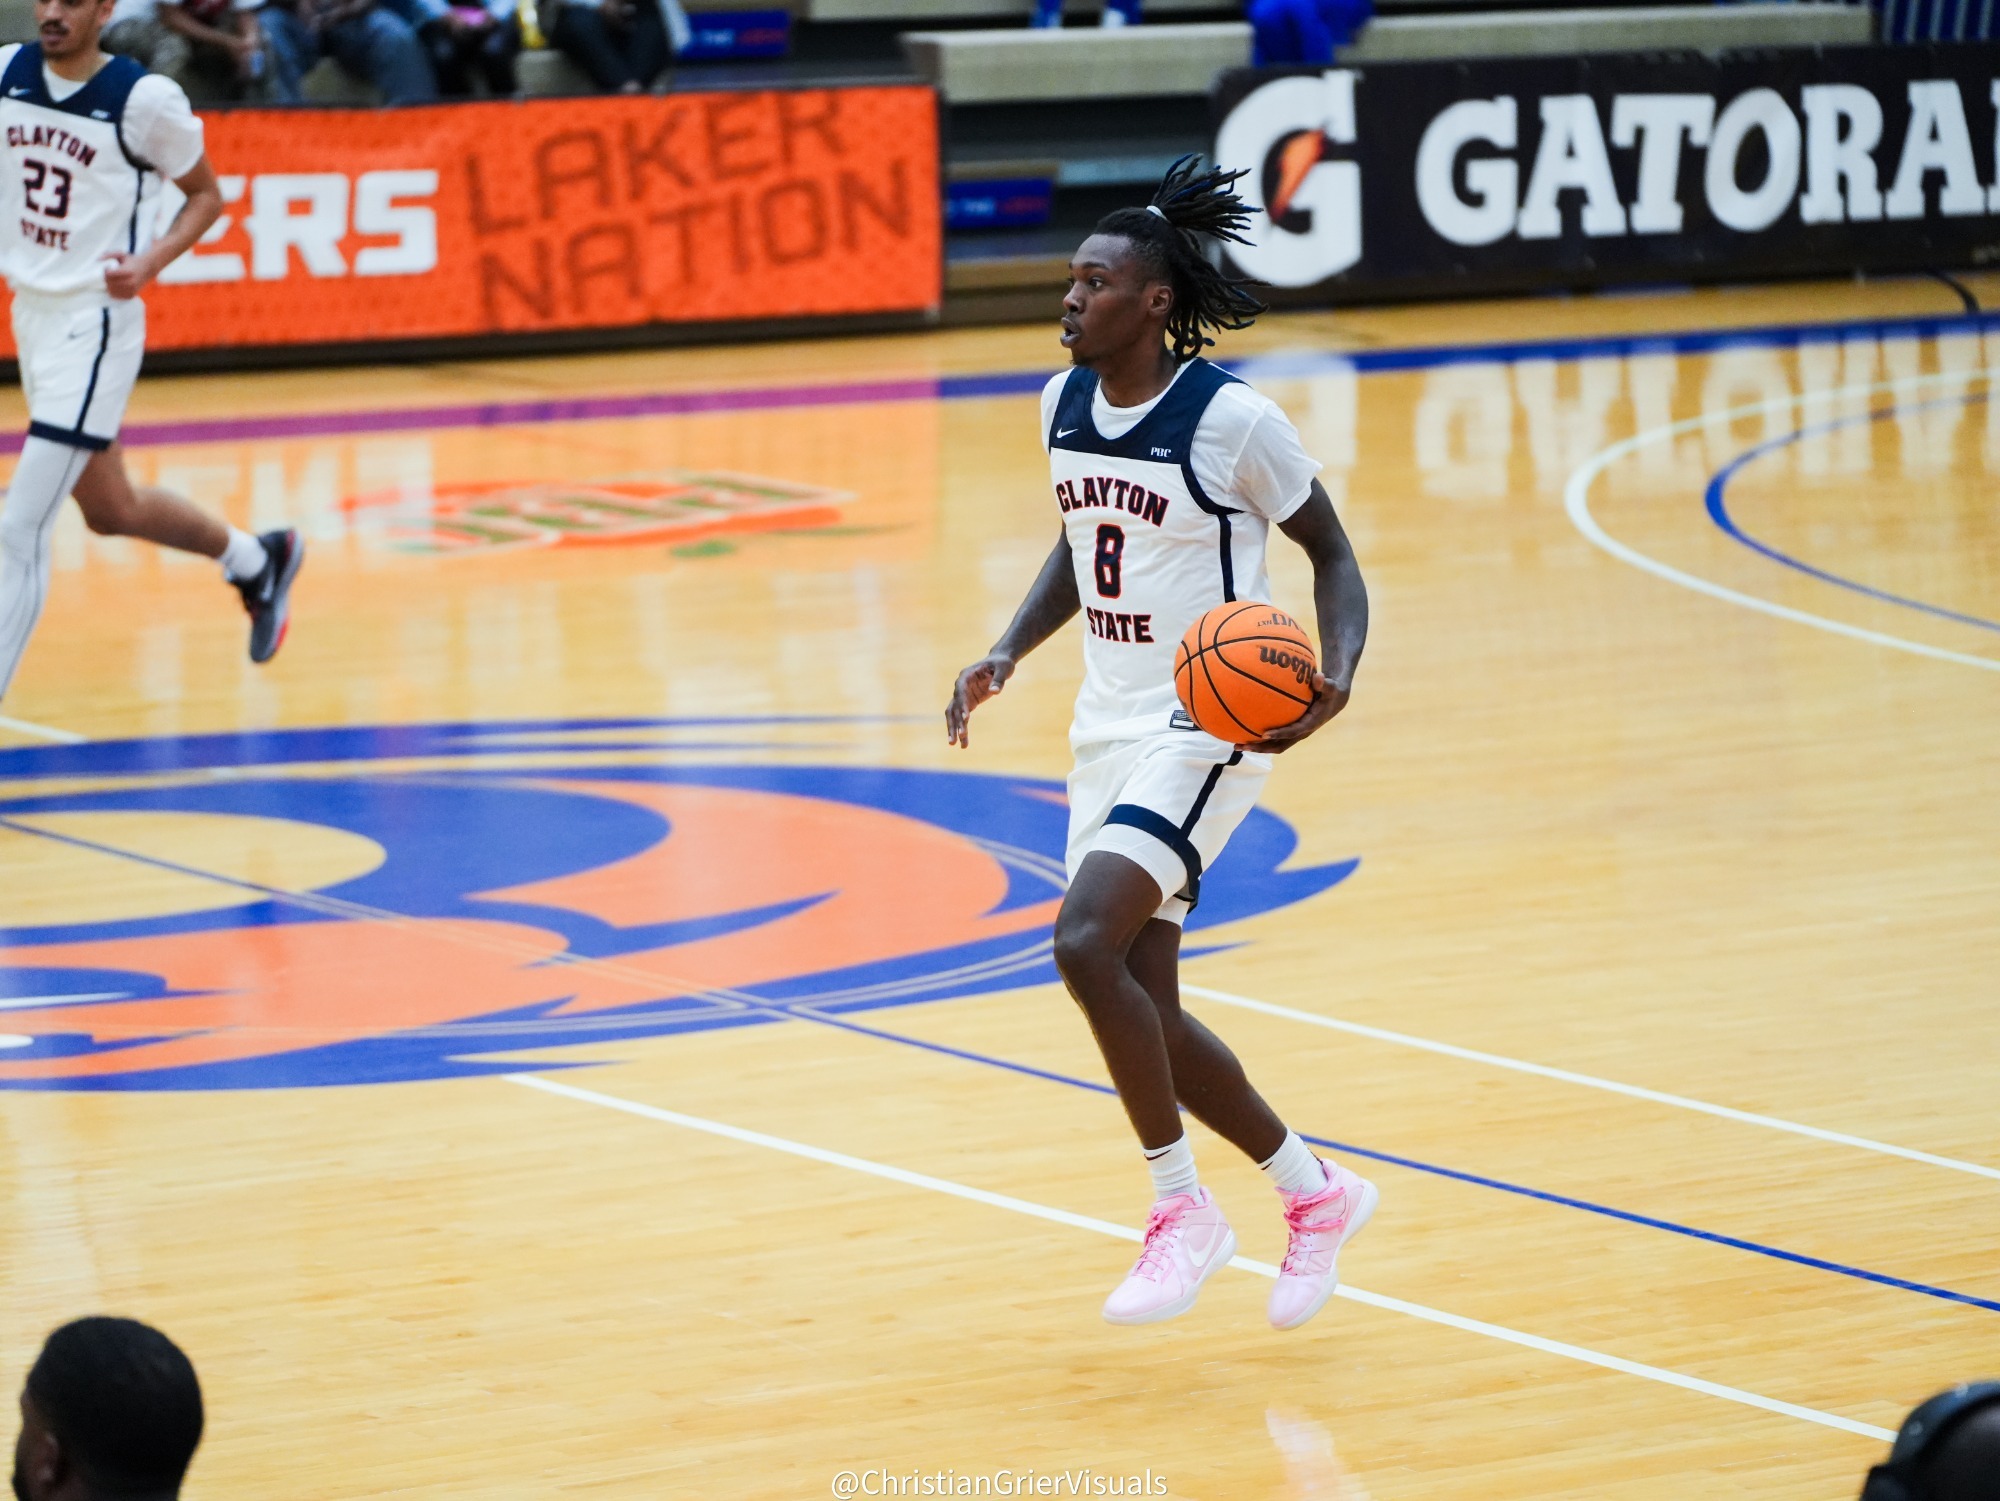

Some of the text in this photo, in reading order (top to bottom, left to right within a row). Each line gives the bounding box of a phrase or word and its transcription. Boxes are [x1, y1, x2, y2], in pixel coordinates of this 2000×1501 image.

[7, 124, 97, 167] CLAYTON
[463, 89, 848, 238] LAKER
[23, 157, 73, 219] 23
[479, 156, 911, 326] NATION
[1150, 446, 1172, 458] PBC
[1055, 477, 1169, 527] CLAYTON
[1094, 523, 1125, 599] 8
[1085, 605, 1155, 643] STATE
